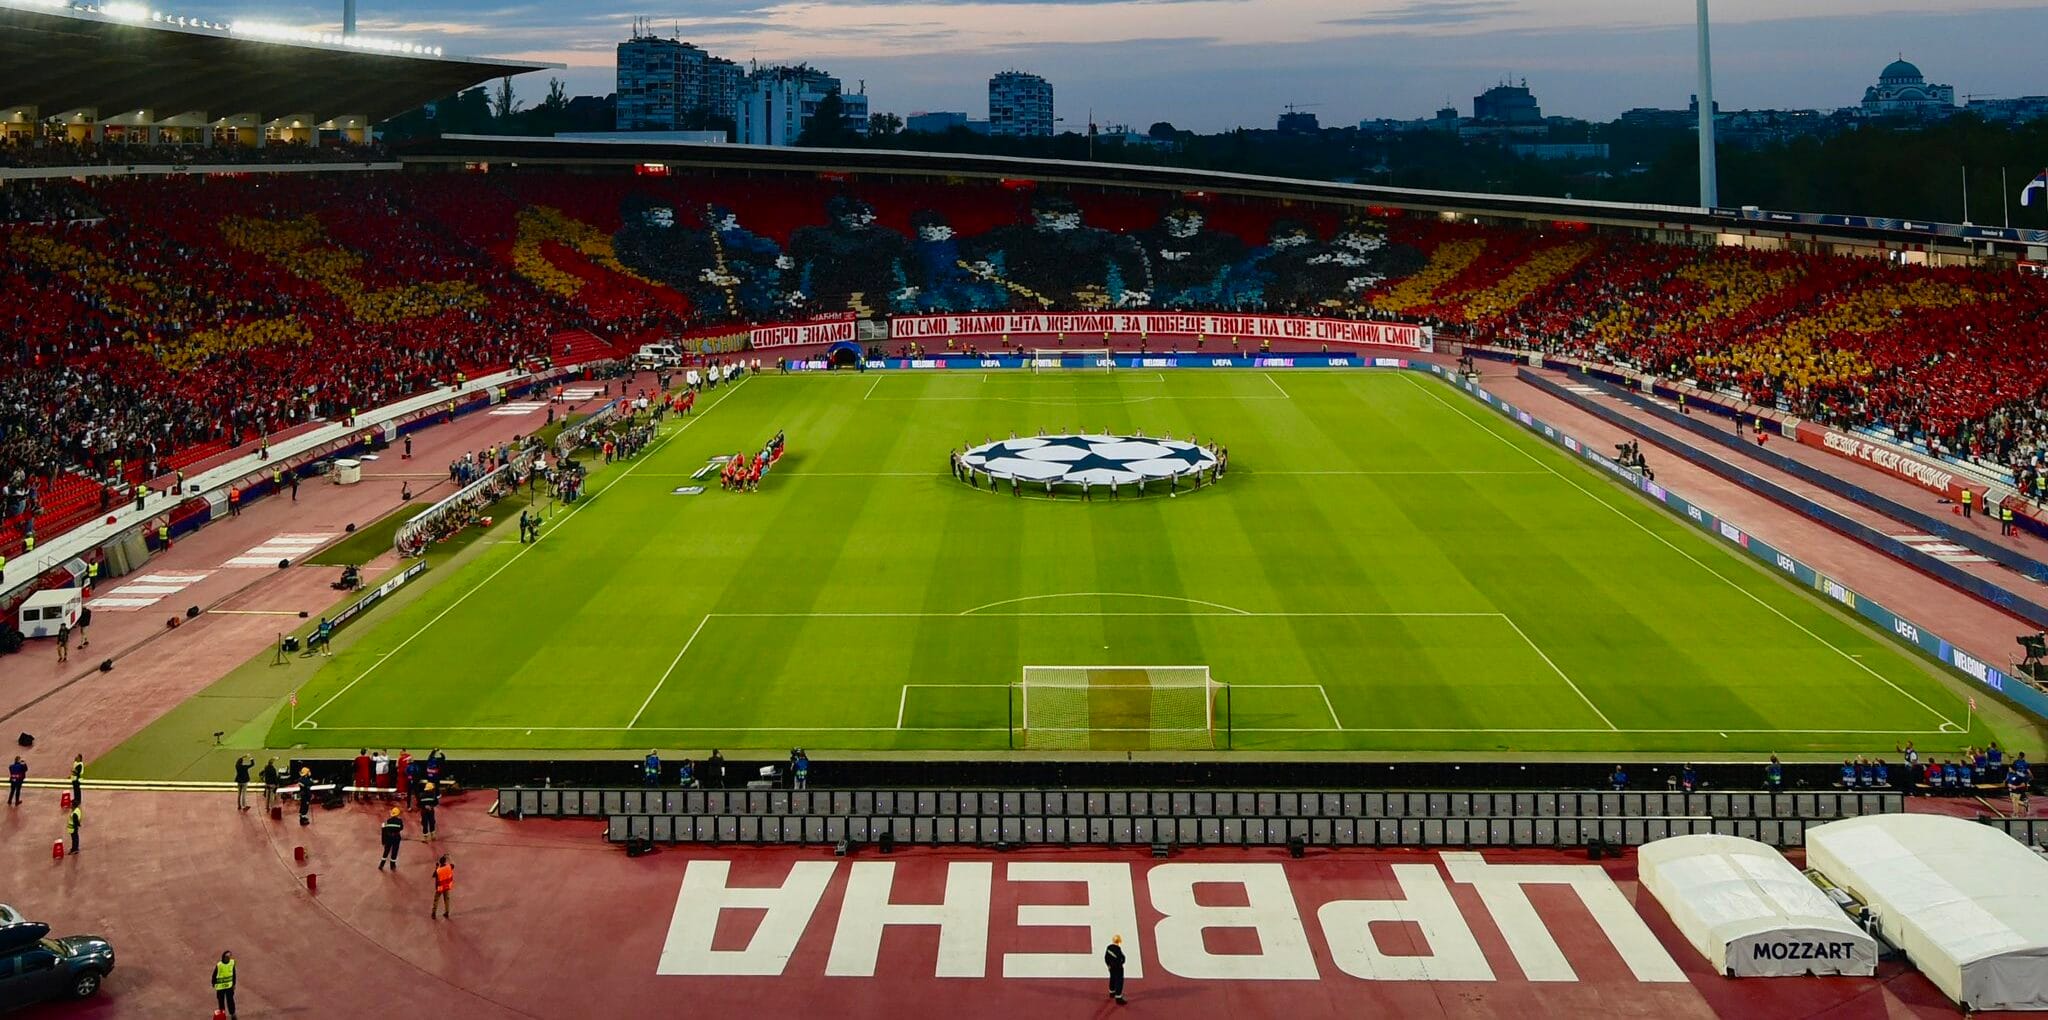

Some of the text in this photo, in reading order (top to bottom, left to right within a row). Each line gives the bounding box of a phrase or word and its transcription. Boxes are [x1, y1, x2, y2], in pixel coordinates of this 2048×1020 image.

[753, 321, 852, 348] ДОБРО ЗНАМО
[896, 319, 914, 337] КО
[954, 316, 1005, 334] ЗНАМО
[1010, 315, 1041, 331] ШТА
[1122, 316, 1141, 331] ЗА
[1147, 316, 1206, 332] ПОБЕДЕ
[1211, 317, 1255, 335] ТВОЈЕ
[1259, 318, 1279, 336] НА
[1283, 319, 1311, 337] СВЕ
[1315, 321, 1381, 344] СПРЕМНИ
[1384, 326, 1416, 346] СМО!
[865, 360, 886, 368] UEFA
[981, 359, 1001, 368] UEFA
[1166, 358, 1178, 367] ALL
[1212, 358, 1233, 367] UEFA
[1328, 358, 1349, 367] UEFA
[1823, 431, 1953, 493] ЗВЕЗДА ЈЕ МОЈА ПОРОДИЦА
[1687, 504, 1703, 522] UEFA
[1776, 553, 1796, 575] UEFA
[1894, 618, 1920, 644] UEFA
[1953, 648, 2004, 692] WELCOME ALL
[656, 851, 1690, 982] ЦРВЕНА
[1753, 942, 1855, 960] MOZZART
